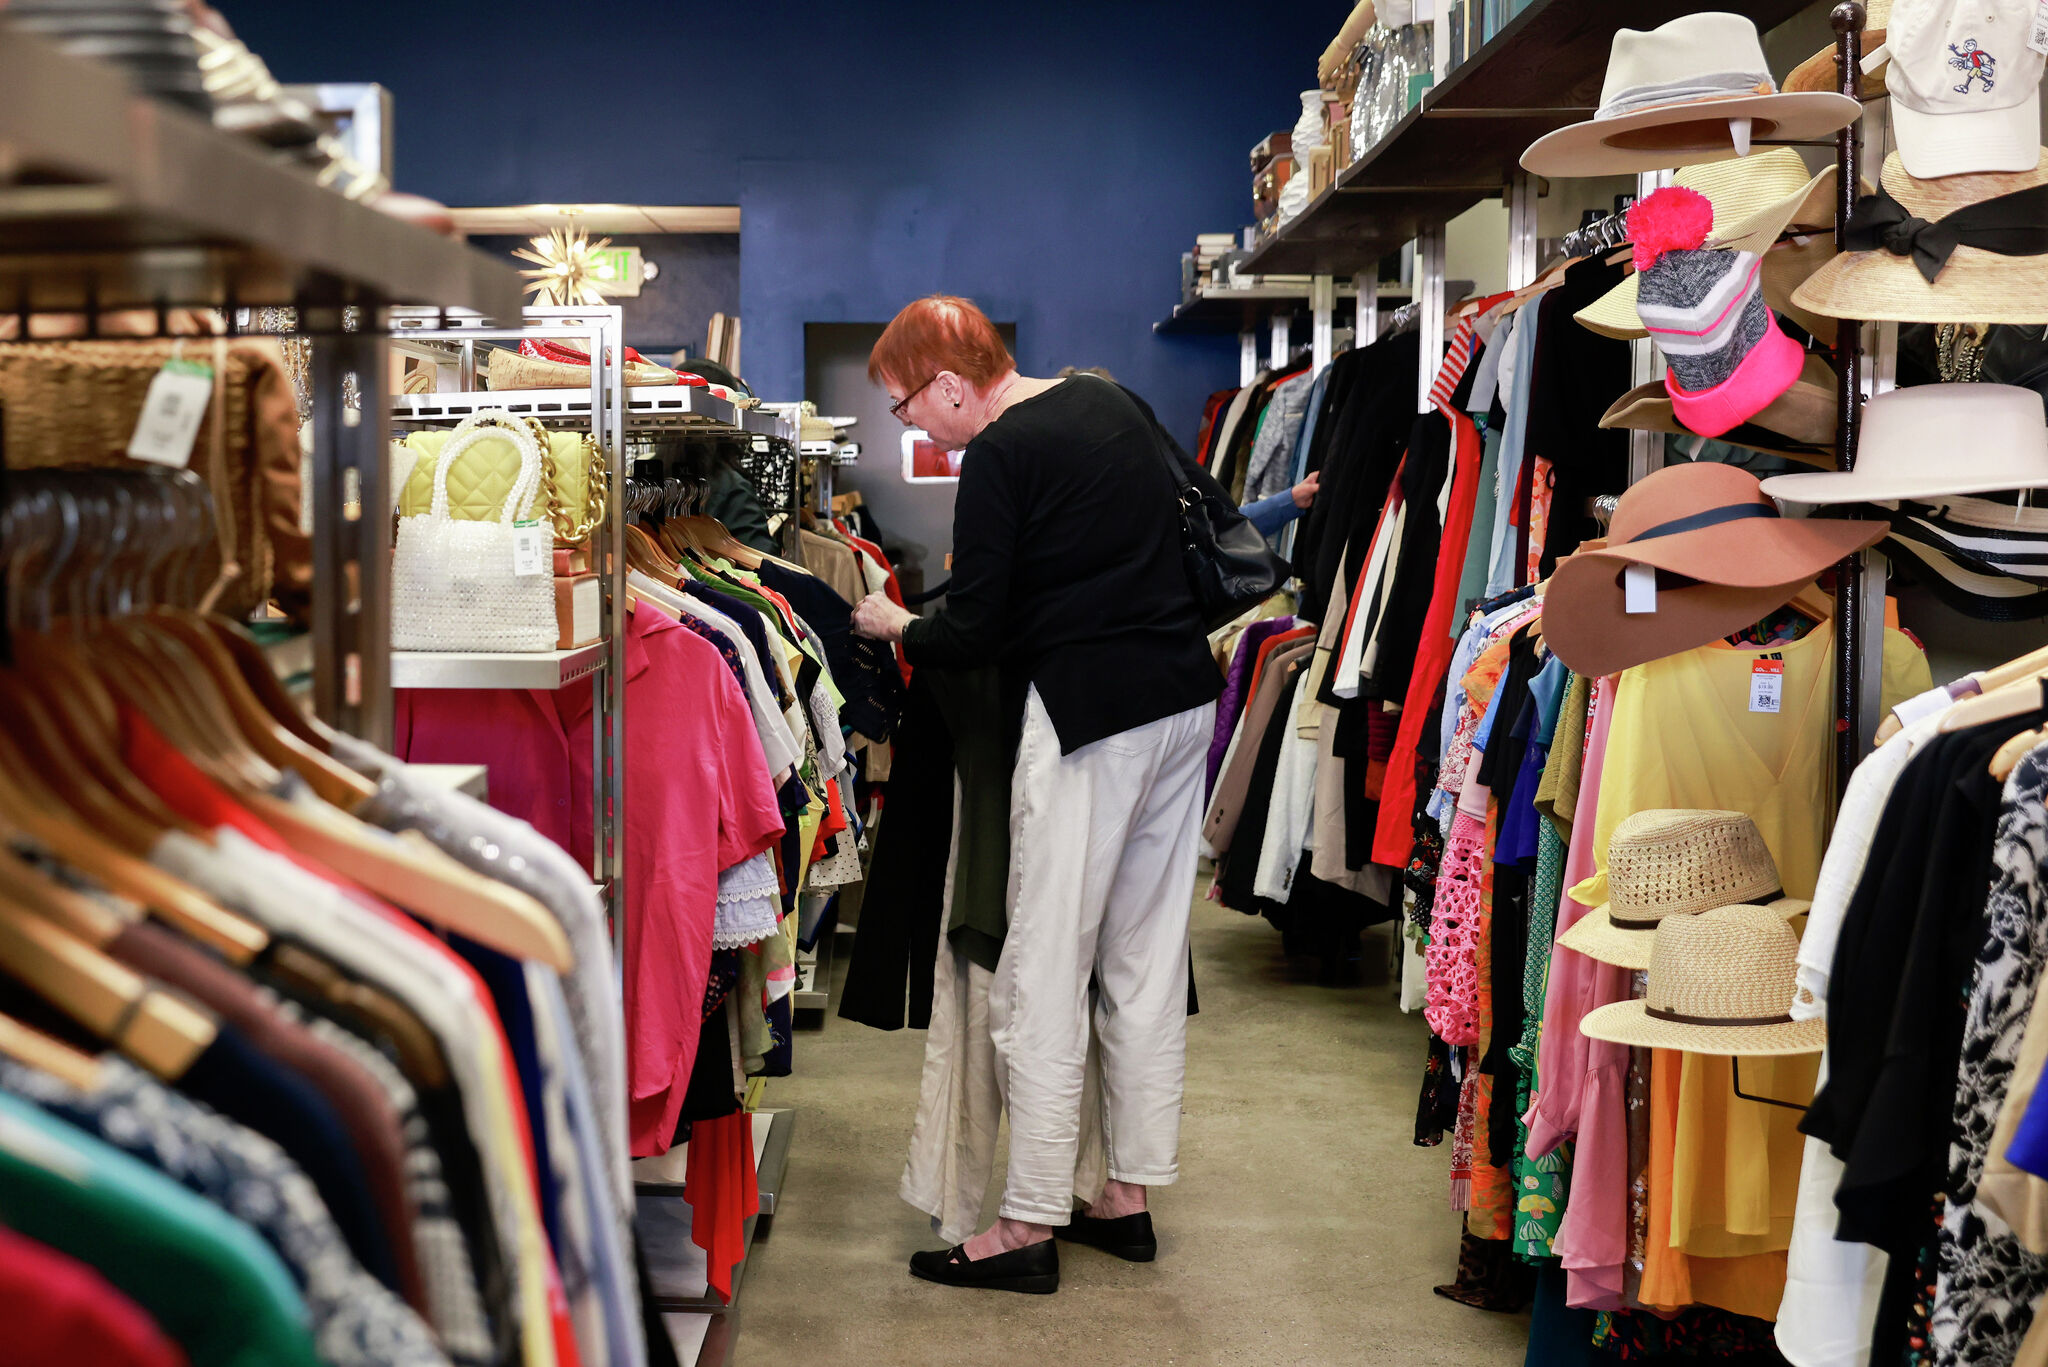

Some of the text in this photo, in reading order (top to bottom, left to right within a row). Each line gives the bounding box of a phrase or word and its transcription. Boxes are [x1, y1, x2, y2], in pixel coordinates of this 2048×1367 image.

[1622, 196, 1633, 207] M
[1591, 212, 1599, 221] L
[589, 251, 632, 281] EIT
[645, 463, 653, 475] L
[680, 466, 693, 476] XL
